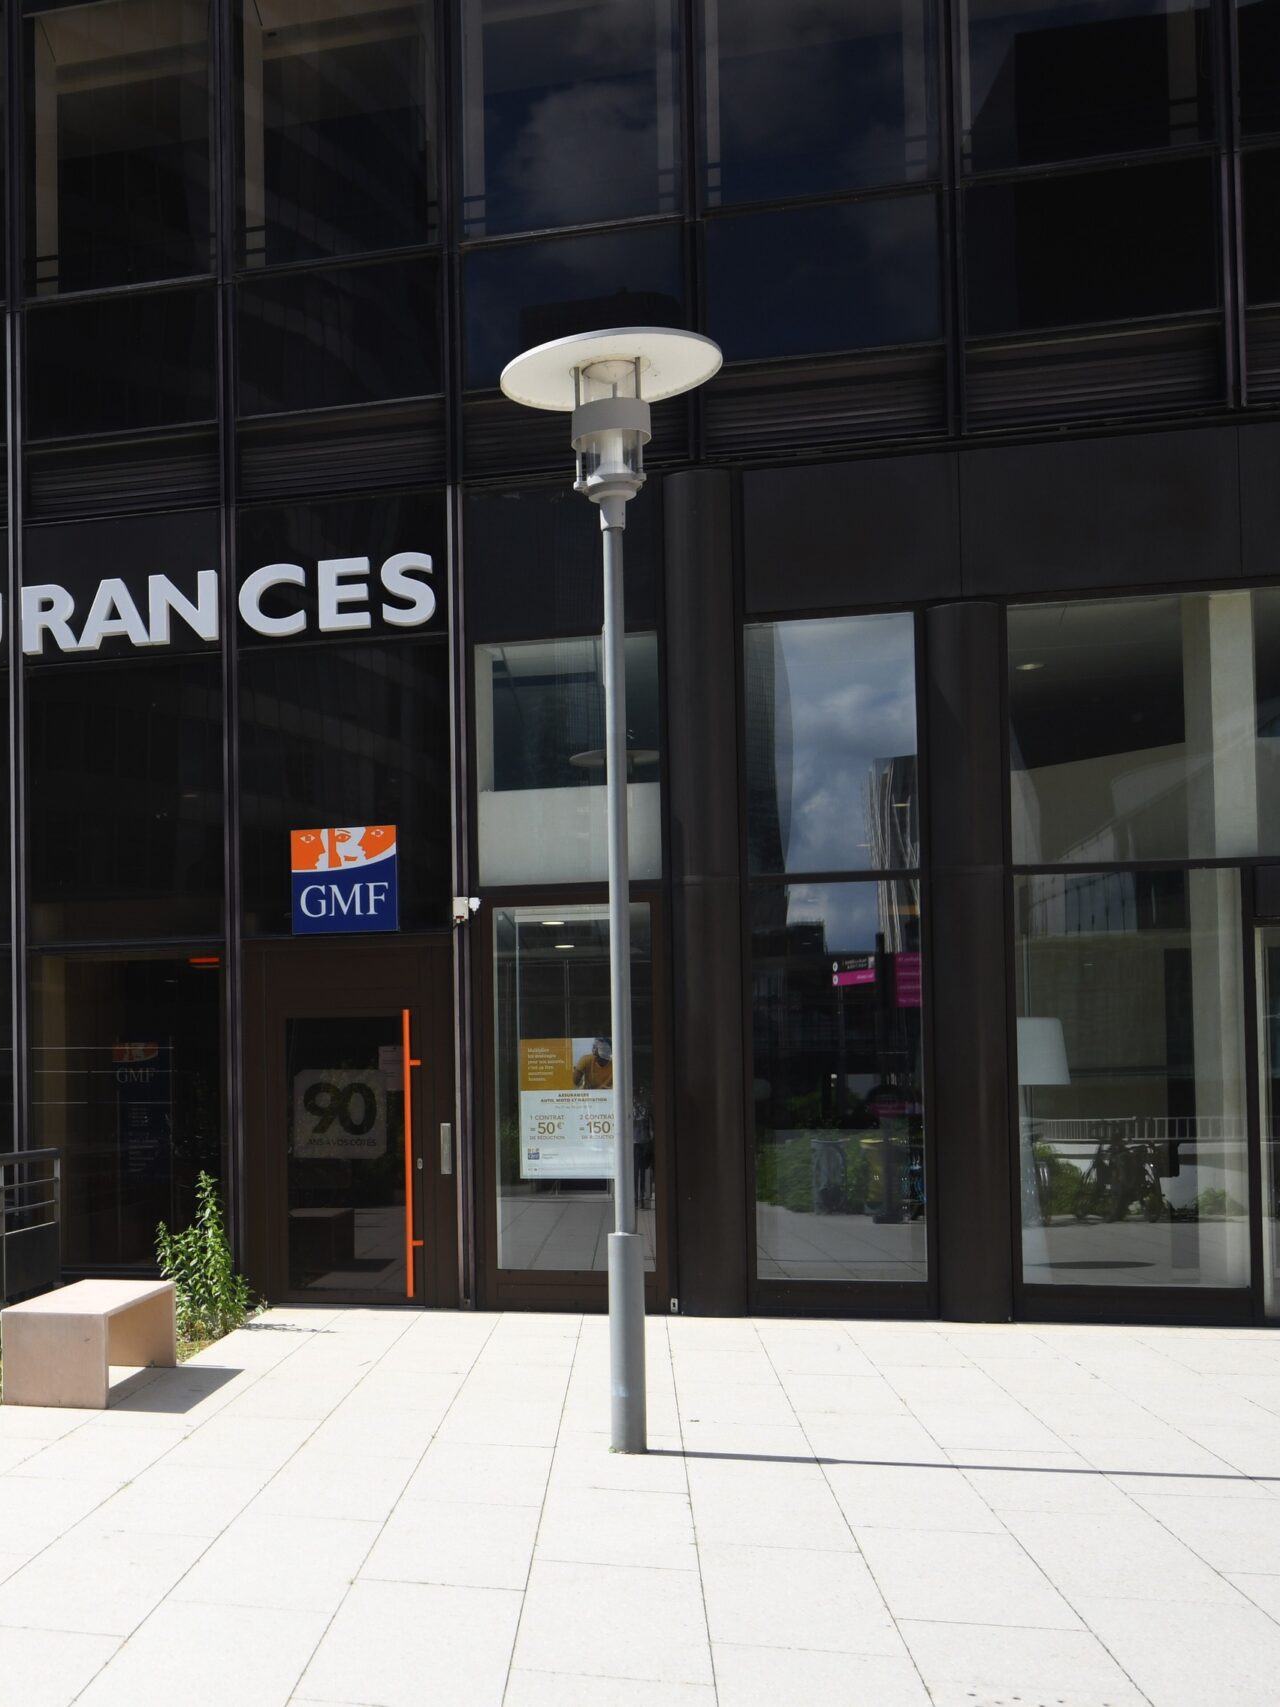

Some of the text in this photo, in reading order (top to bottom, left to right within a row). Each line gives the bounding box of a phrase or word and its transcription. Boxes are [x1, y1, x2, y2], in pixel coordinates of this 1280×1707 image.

[300, 882, 388, 918] GMF
[116, 1067, 156, 1084] GMF
[303, 1082, 377, 1136] 90
[331, 1138, 348, 1146] VOS
